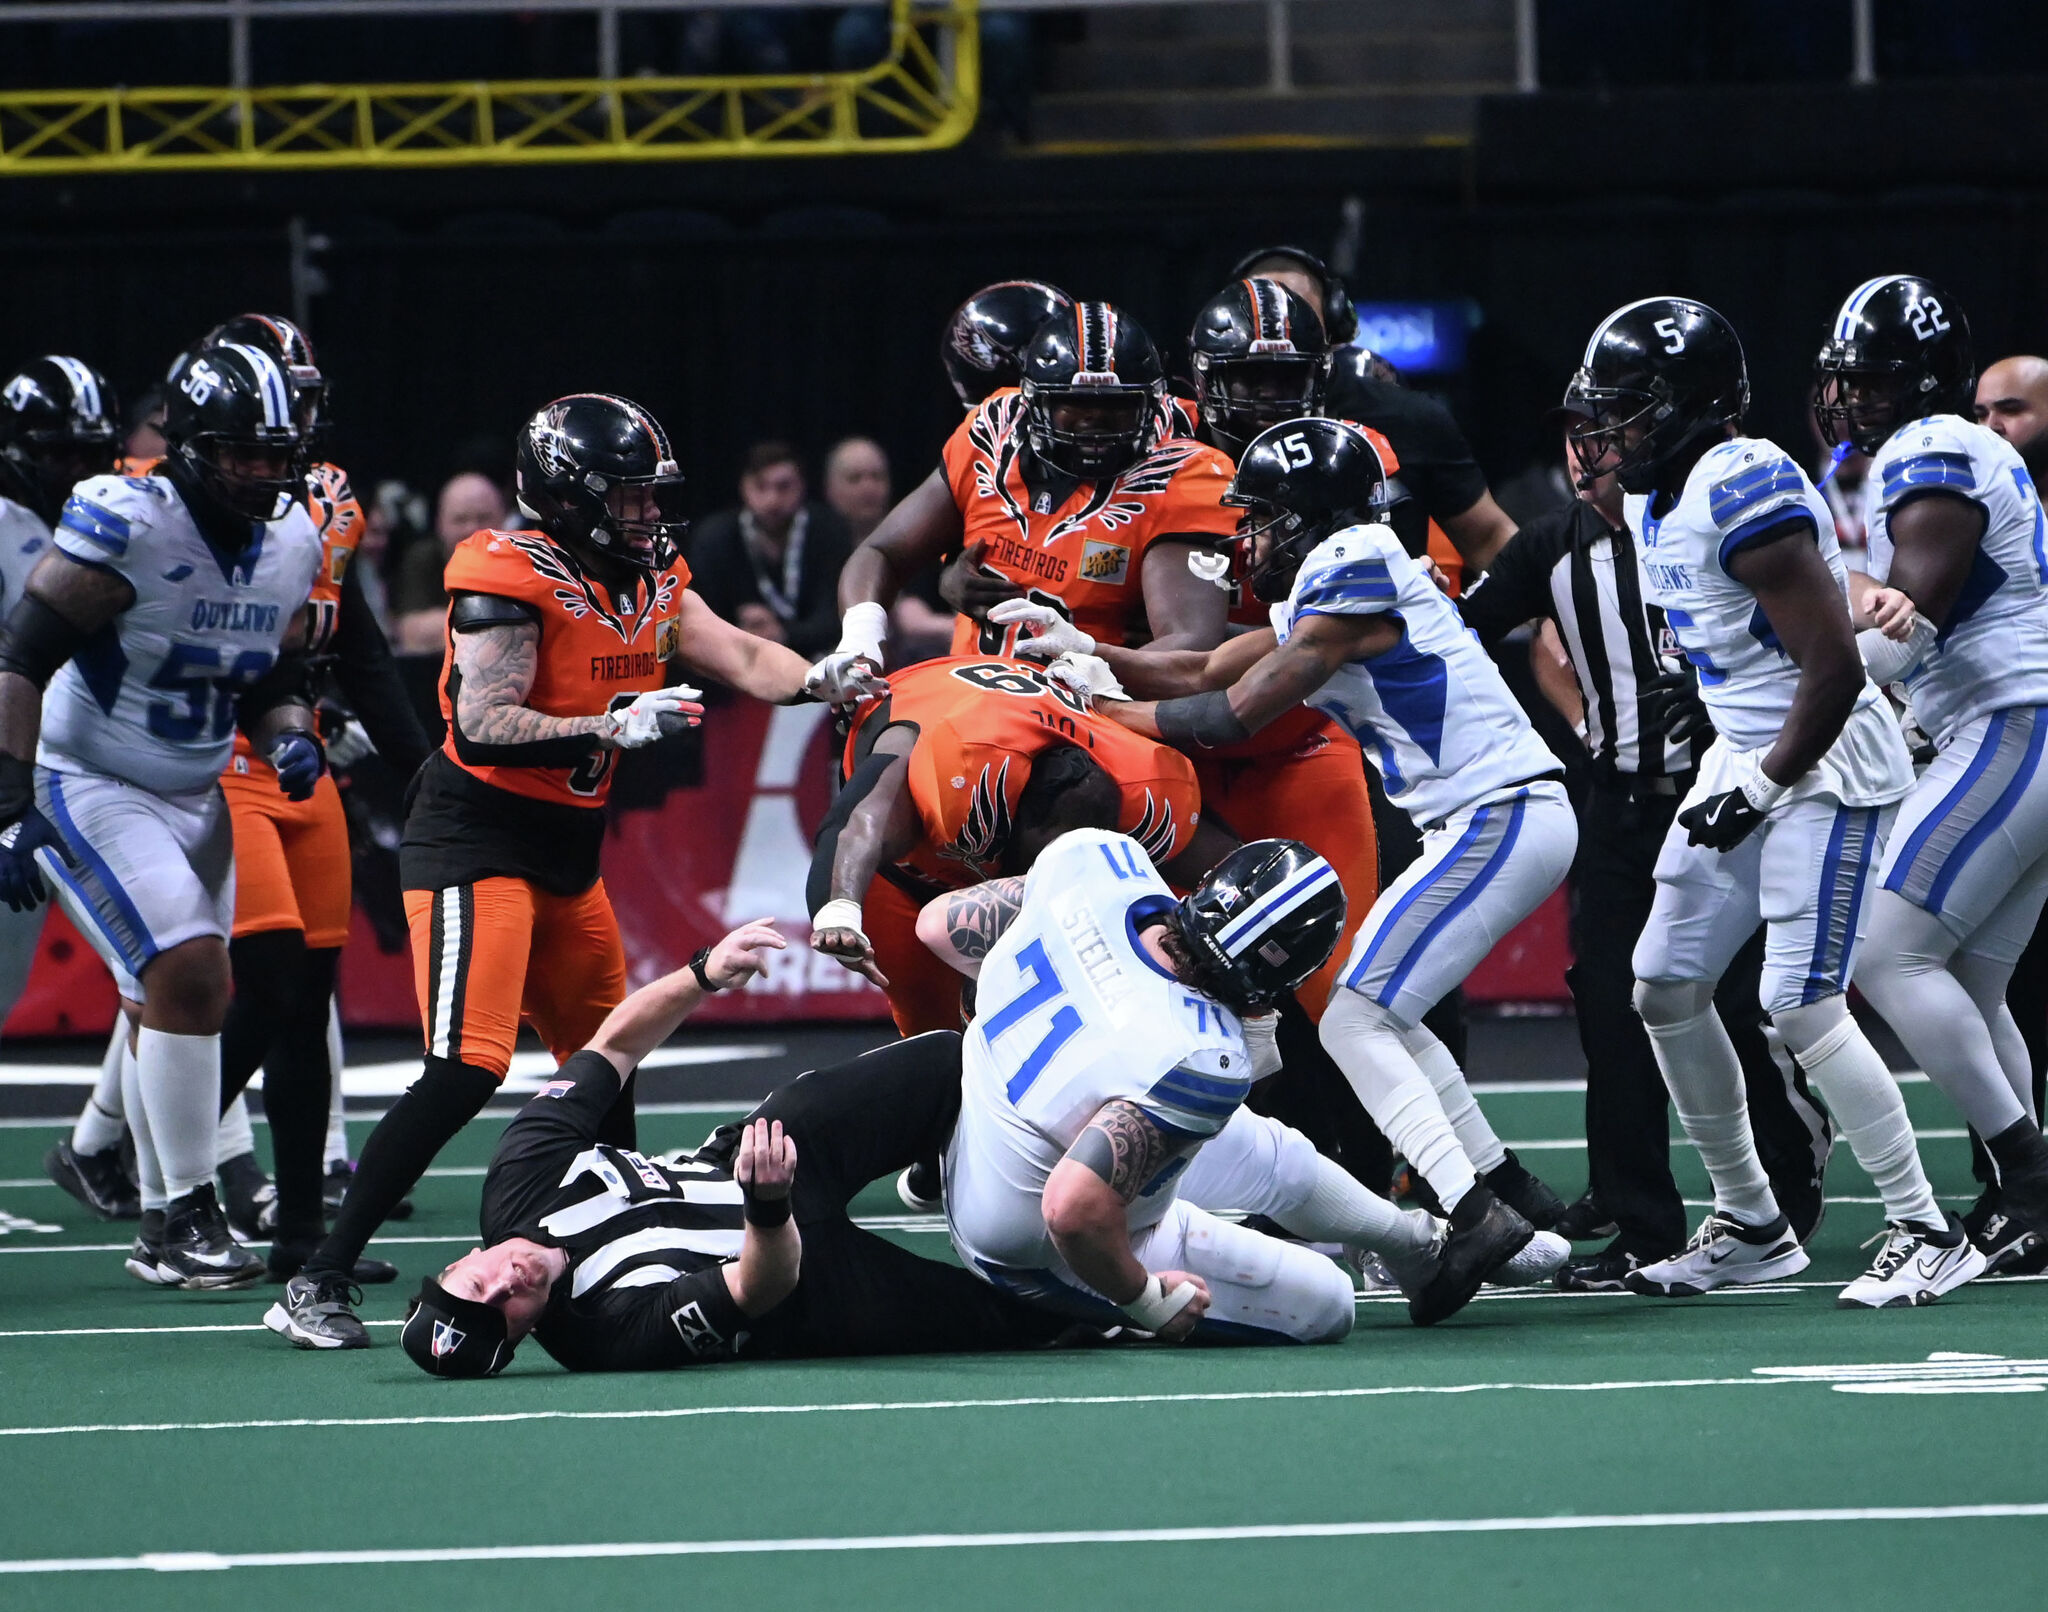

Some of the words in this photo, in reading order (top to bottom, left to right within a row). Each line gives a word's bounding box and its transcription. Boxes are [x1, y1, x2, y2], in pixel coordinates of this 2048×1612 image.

[1654, 317, 1685, 354] 5
[1904, 296, 1951, 341] 22
[180, 359, 221, 406] 56
[1078, 375, 1115, 385] ALBANY
[1272, 431, 1314, 474] 15
[992, 536, 1069, 582] FIREBIRDS
[191, 598, 280, 632] OUTLAWS
[591, 651, 656, 682] FIREBIRDS
[1202, 934, 1233, 970] XENITH
[980, 936, 1087, 1108] 71
[1183, 995, 1230, 1037] 71
